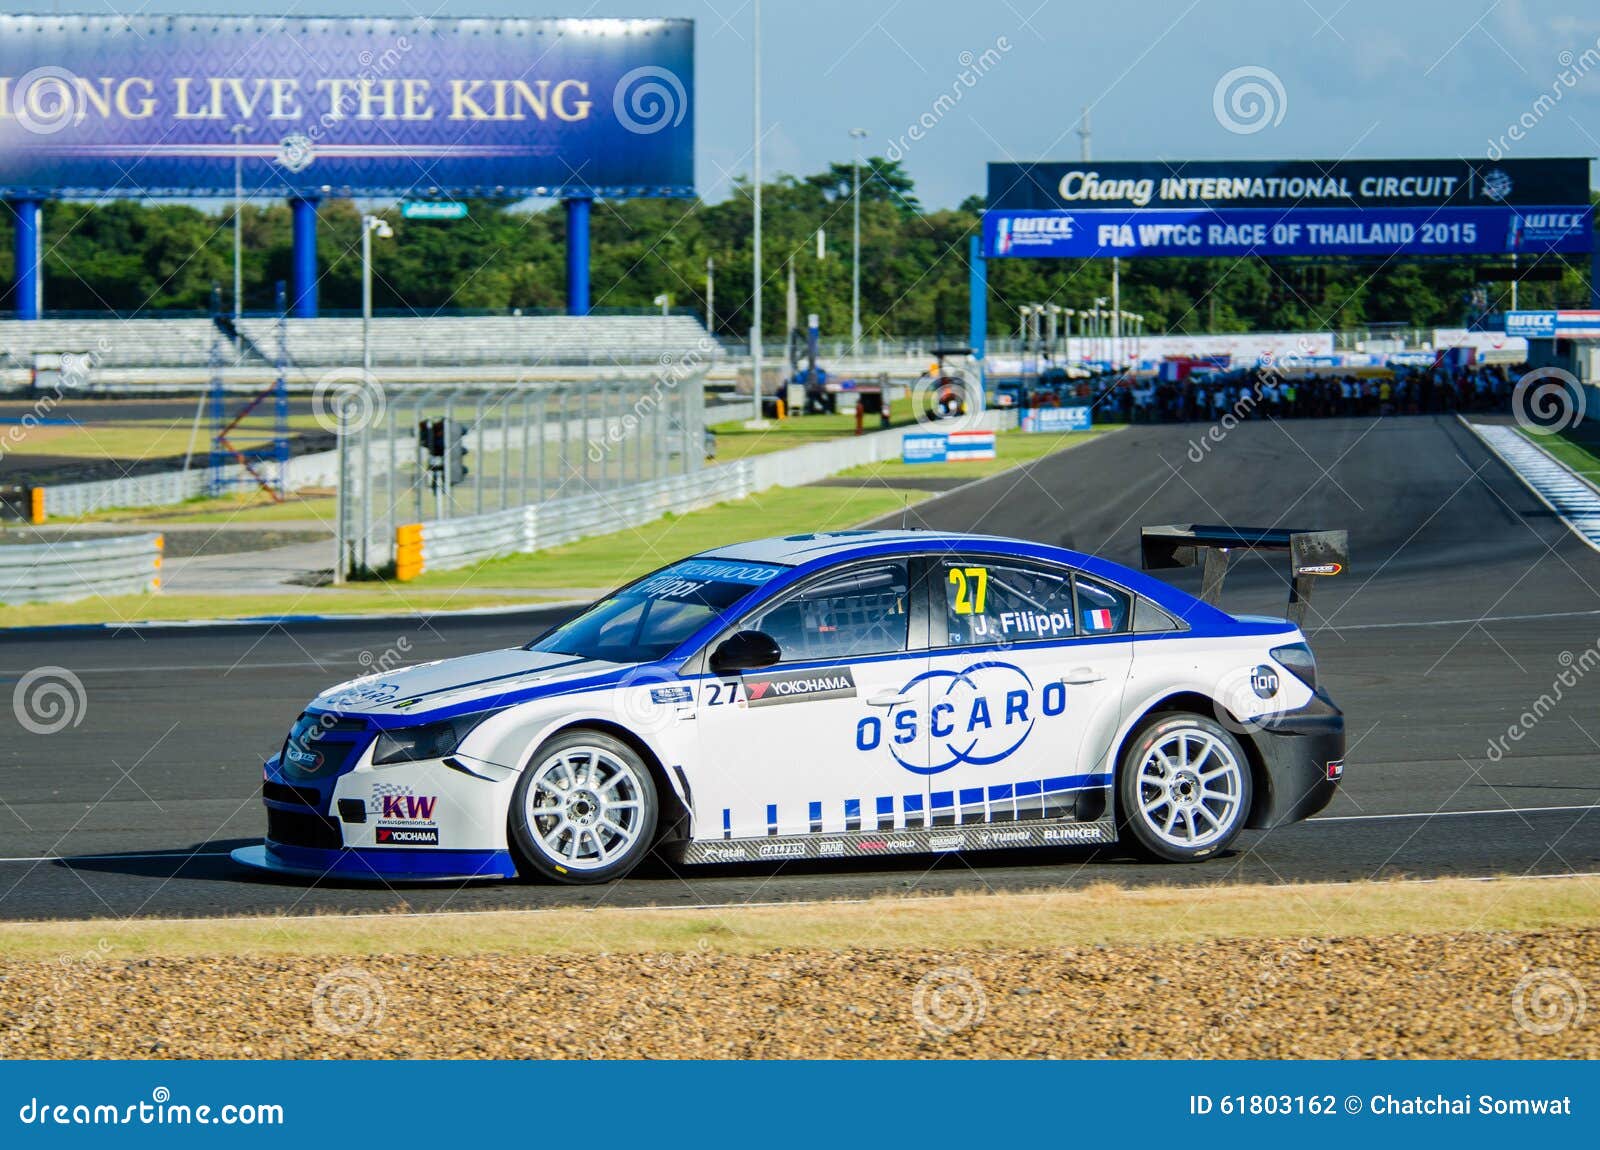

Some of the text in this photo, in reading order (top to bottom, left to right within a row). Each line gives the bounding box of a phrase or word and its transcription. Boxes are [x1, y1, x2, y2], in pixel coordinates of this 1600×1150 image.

[173, 77, 302, 120] LIVE
[316, 78, 434, 121] THE
[448, 79, 592, 121] KING
[1058, 171, 1458, 206] Chang INTERNATIONAL CIRCUIT
[1524, 213, 1585, 228] WTCC
[1097, 225, 1136, 247] FIA
[1138, 225, 1203, 246] WTCC
[1208, 224, 1267, 245] RACE
[1272, 224, 1301, 245] OF
[1306, 223, 1415, 244] THAILAND
[1421, 223, 1477, 244] 2015
[949, 567, 987, 614] 27
[974, 608, 1073, 636] J. Filippi
[770, 676, 851, 695] YOKOHAMA
[1251, 668, 1278, 690] ion
[705, 682, 739, 706] 27
[857, 682, 1066, 751] OSCARO
[383, 796, 437, 819] KW
[391, 832, 437, 841] YOKOHAMA
[1044, 829, 1101, 839] BLINKER
